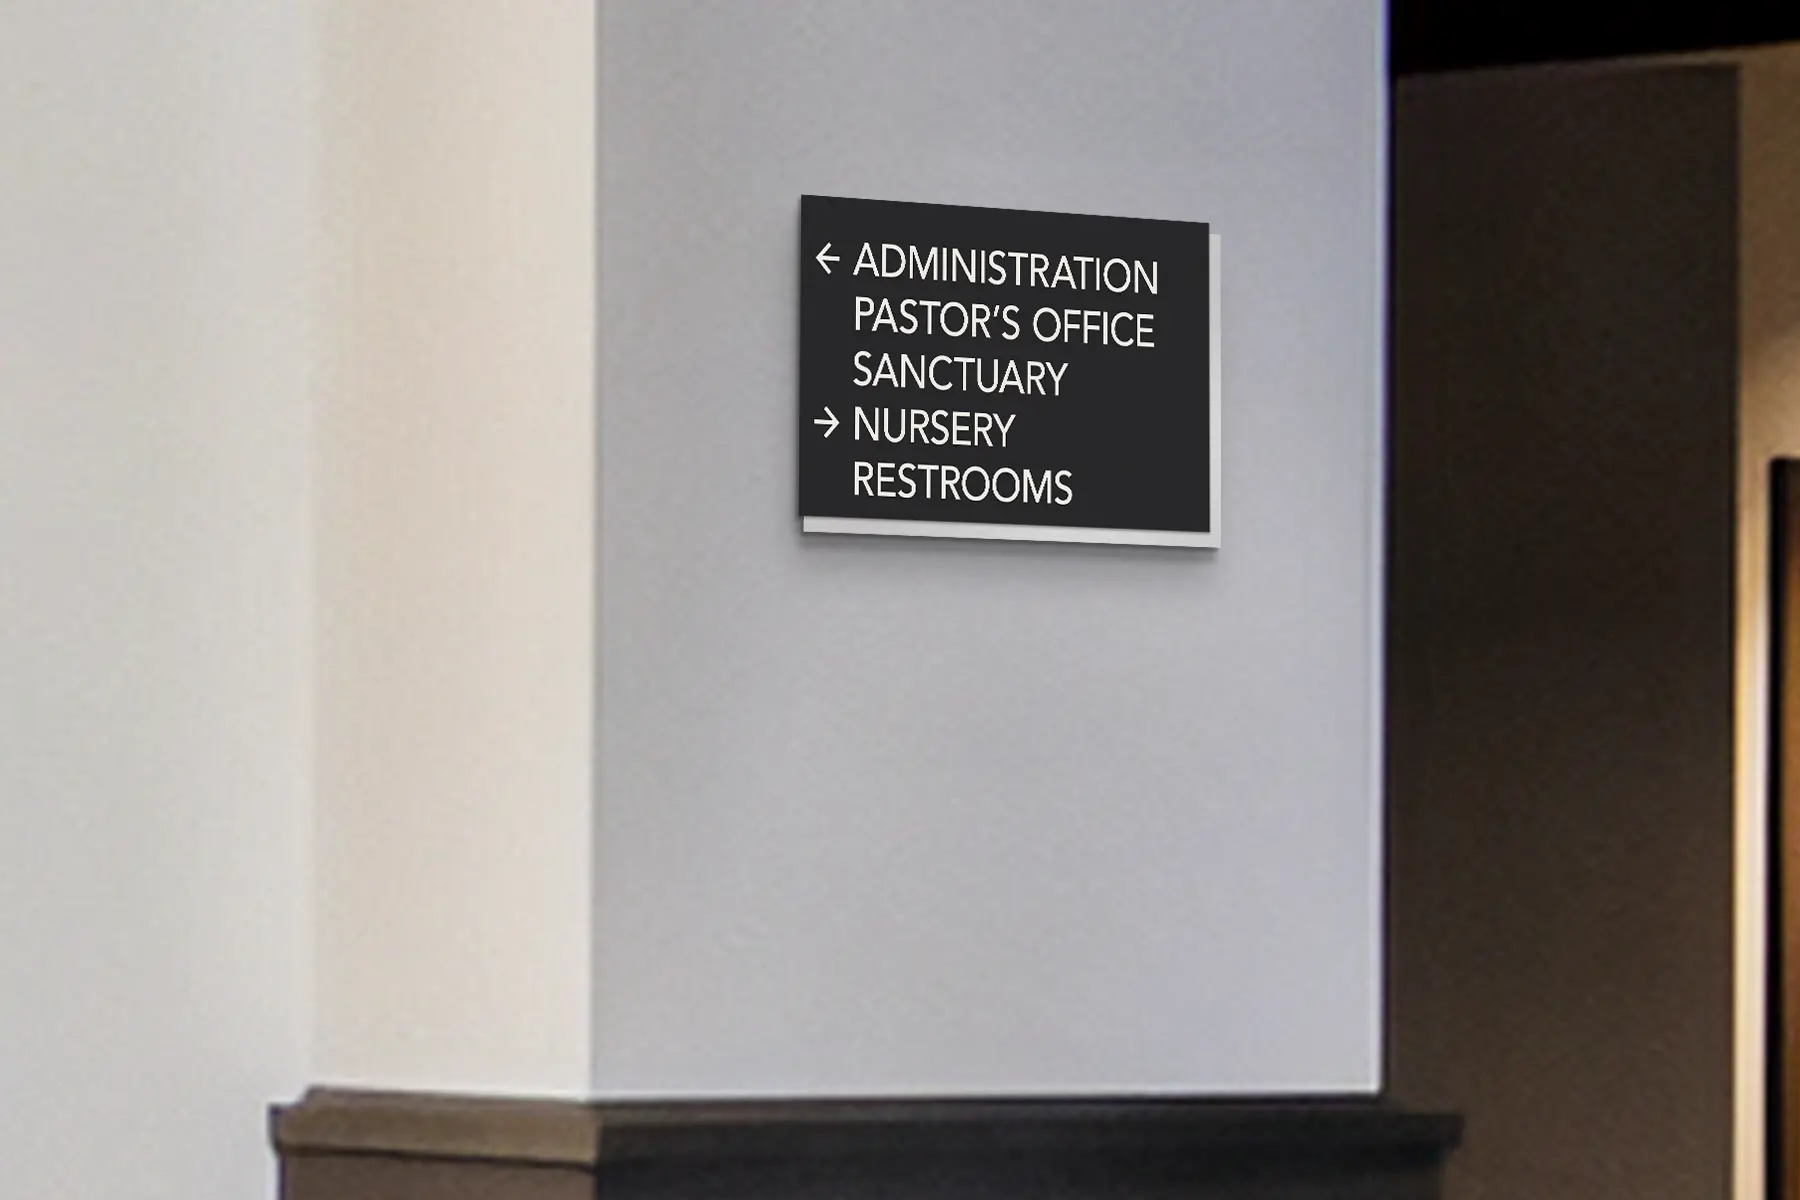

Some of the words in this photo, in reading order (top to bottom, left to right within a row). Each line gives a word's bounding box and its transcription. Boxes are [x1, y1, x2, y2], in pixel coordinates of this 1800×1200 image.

[852, 242, 1158, 294] ADMINISTRATION
[855, 295, 1021, 340] PASTOR'S
[1032, 306, 1155, 348] OFFICE
[852, 350, 1069, 396] SANCTUARY
[854, 405, 1017, 448] NURSERY
[854, 460, 1073, 506] RESTROOMS
